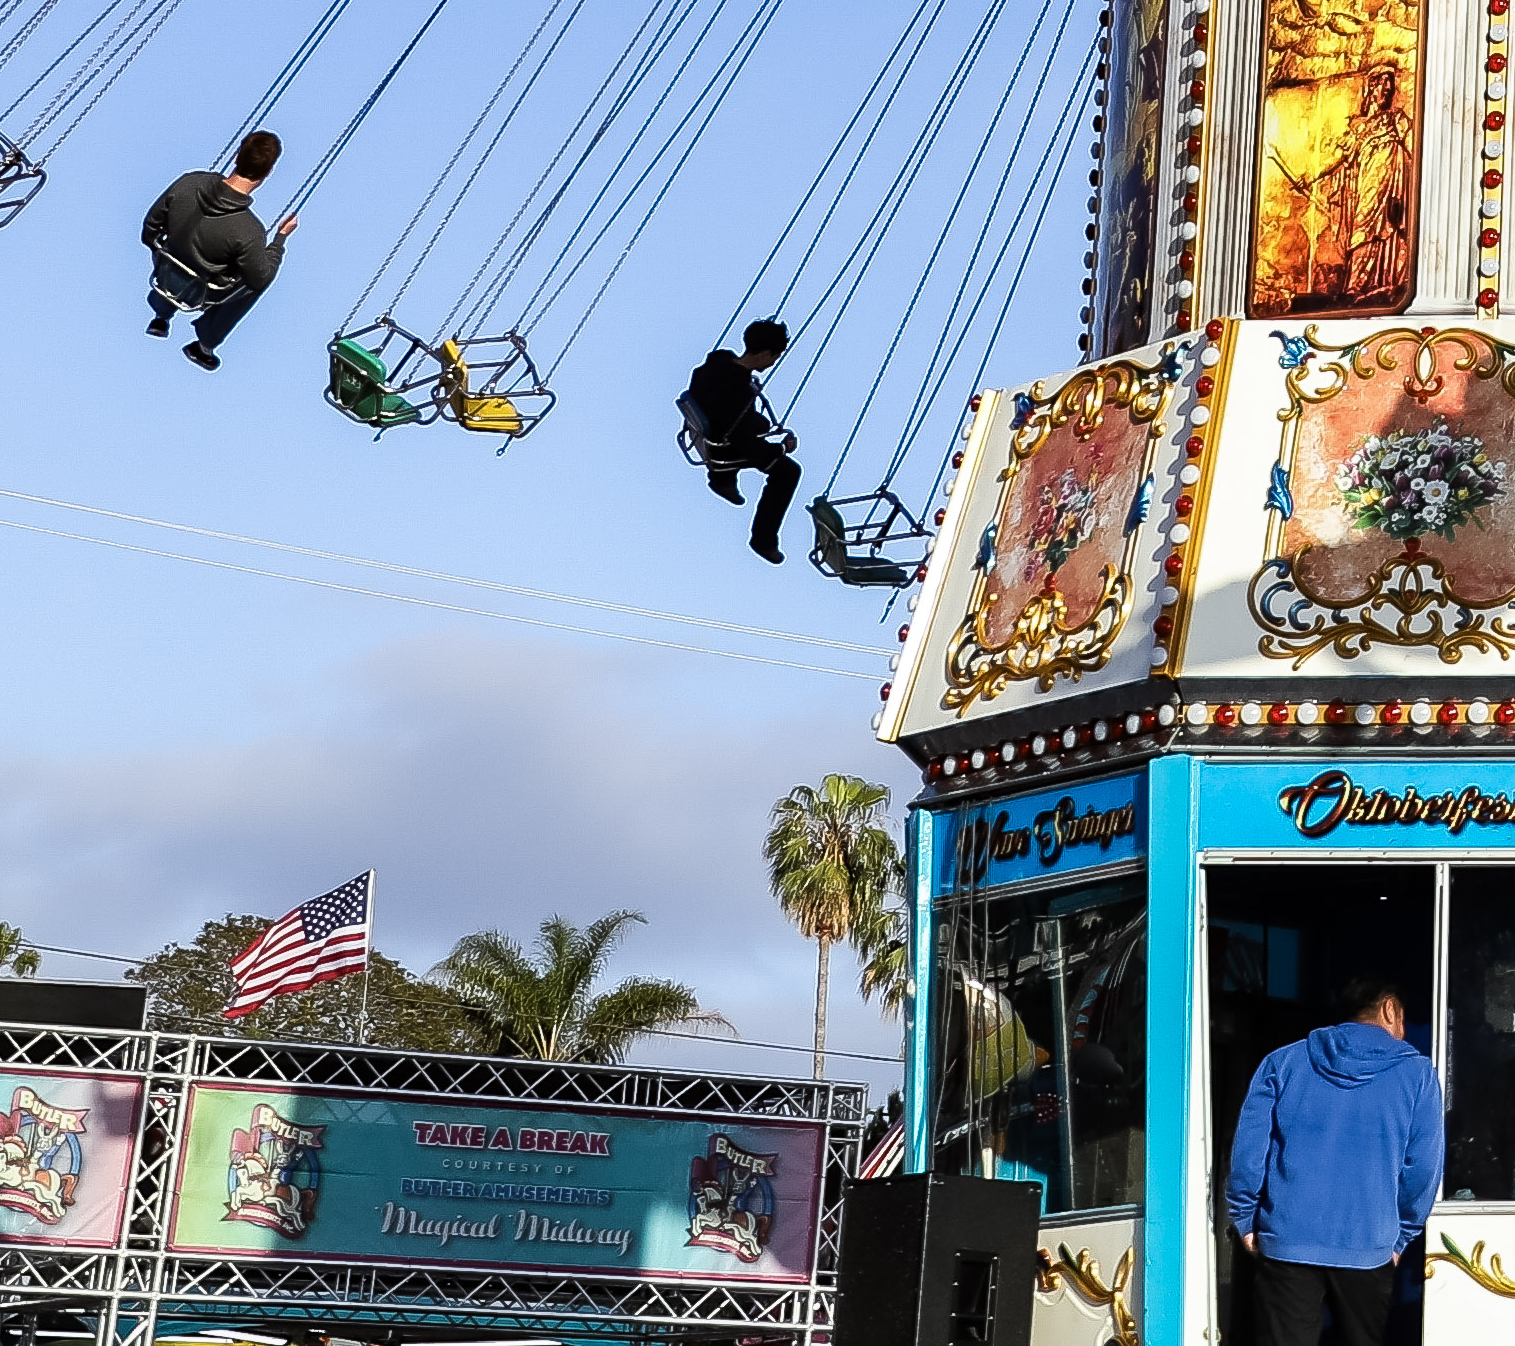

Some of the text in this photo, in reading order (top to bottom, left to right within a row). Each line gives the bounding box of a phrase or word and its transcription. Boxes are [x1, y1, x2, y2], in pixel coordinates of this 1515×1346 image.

[19, 1090, 77, 1131] BUTLER
[259, 1107, 314, 1146] BUTLER
[413, 1121, 610, 1155] TAKE A BREAK
[716, 1137, 766, 1174] BUTLER
[442, 1159, 576, 1175] COURTESY OF
[401, 1178, 611, 1205] BUTLER AMUSEMENTS
[375, 1202, 632, 1256] Magical Midway
